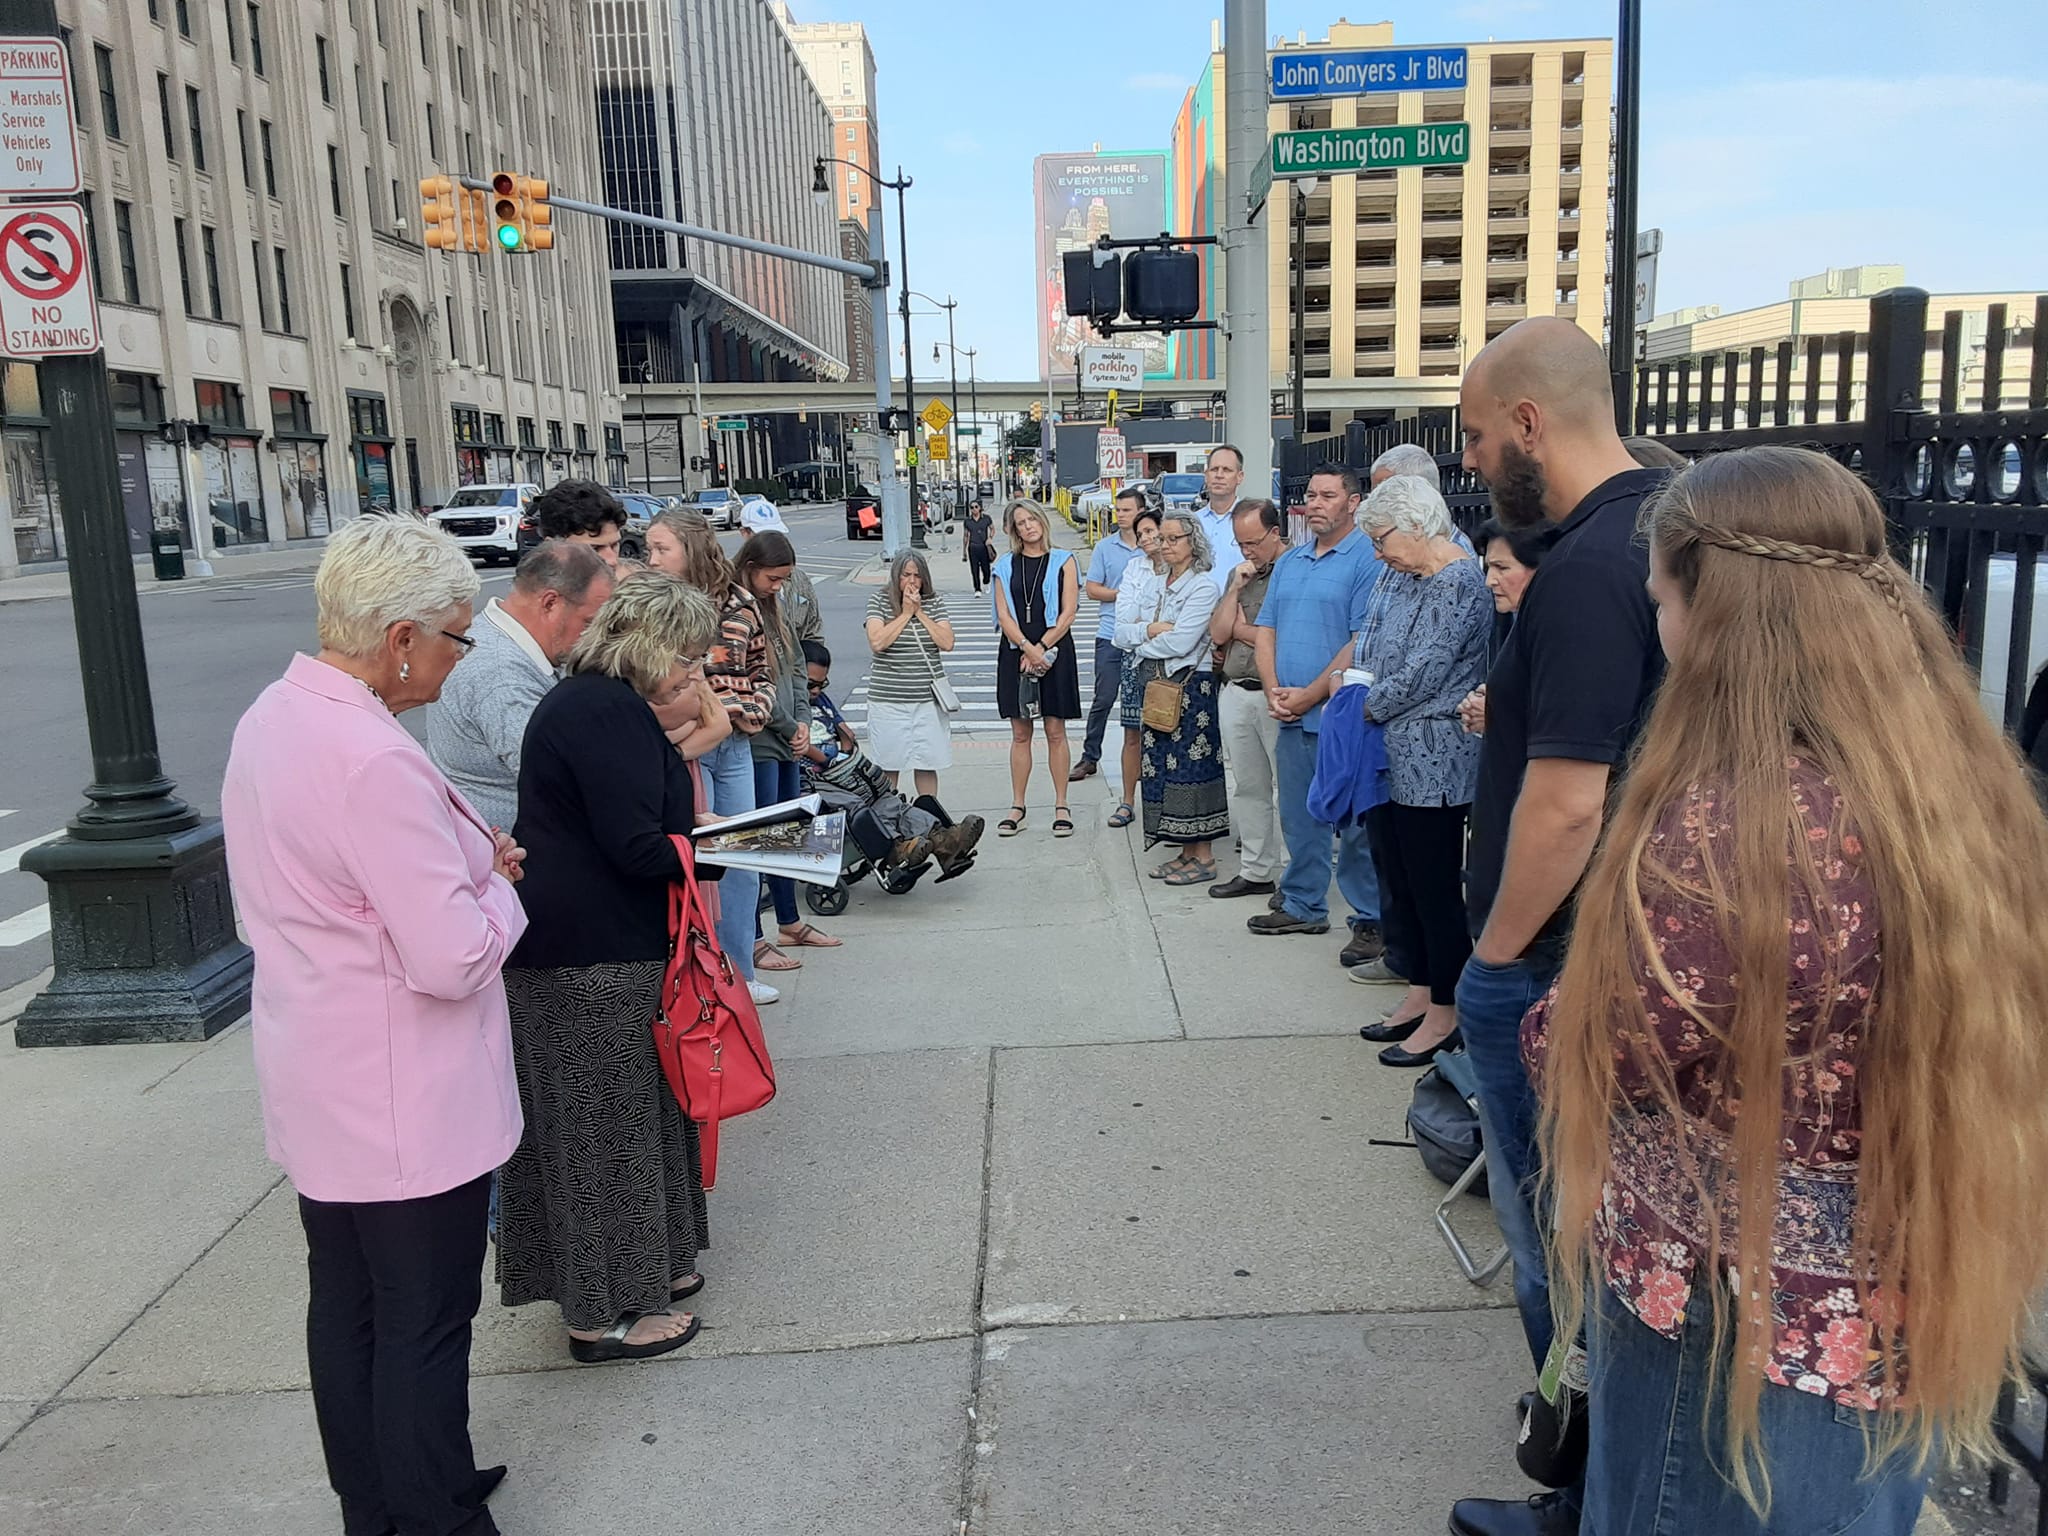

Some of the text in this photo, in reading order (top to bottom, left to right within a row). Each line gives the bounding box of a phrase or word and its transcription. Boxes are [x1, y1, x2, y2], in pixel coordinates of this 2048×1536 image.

[1, 51, 59, 70] PARKING
[1276, 56, 1464, 87] John Conyers Jr Blvd
[10, 90, 62, 106] Marshals
[2, 112, 45, 128] Service
[2, 134, 51, 150] Vehicles
[1277, 128, 1464, 166] Washington Blvd
[16, 156, 43, 176] Only
[1066, 166, 1101, 175] FROM
[1058, 174, 1149, 186] EVERYTHING IS
[1074, 186, 1134, 196] POSSIBLE
[32, 306, 62, 325] NO
[11, 328, 90, 349] STANDING
[1101, 351, 1126, 360] mobile
[1089, 360, 1137, 376] parking
[1092, 374, 1119, 382] systems
